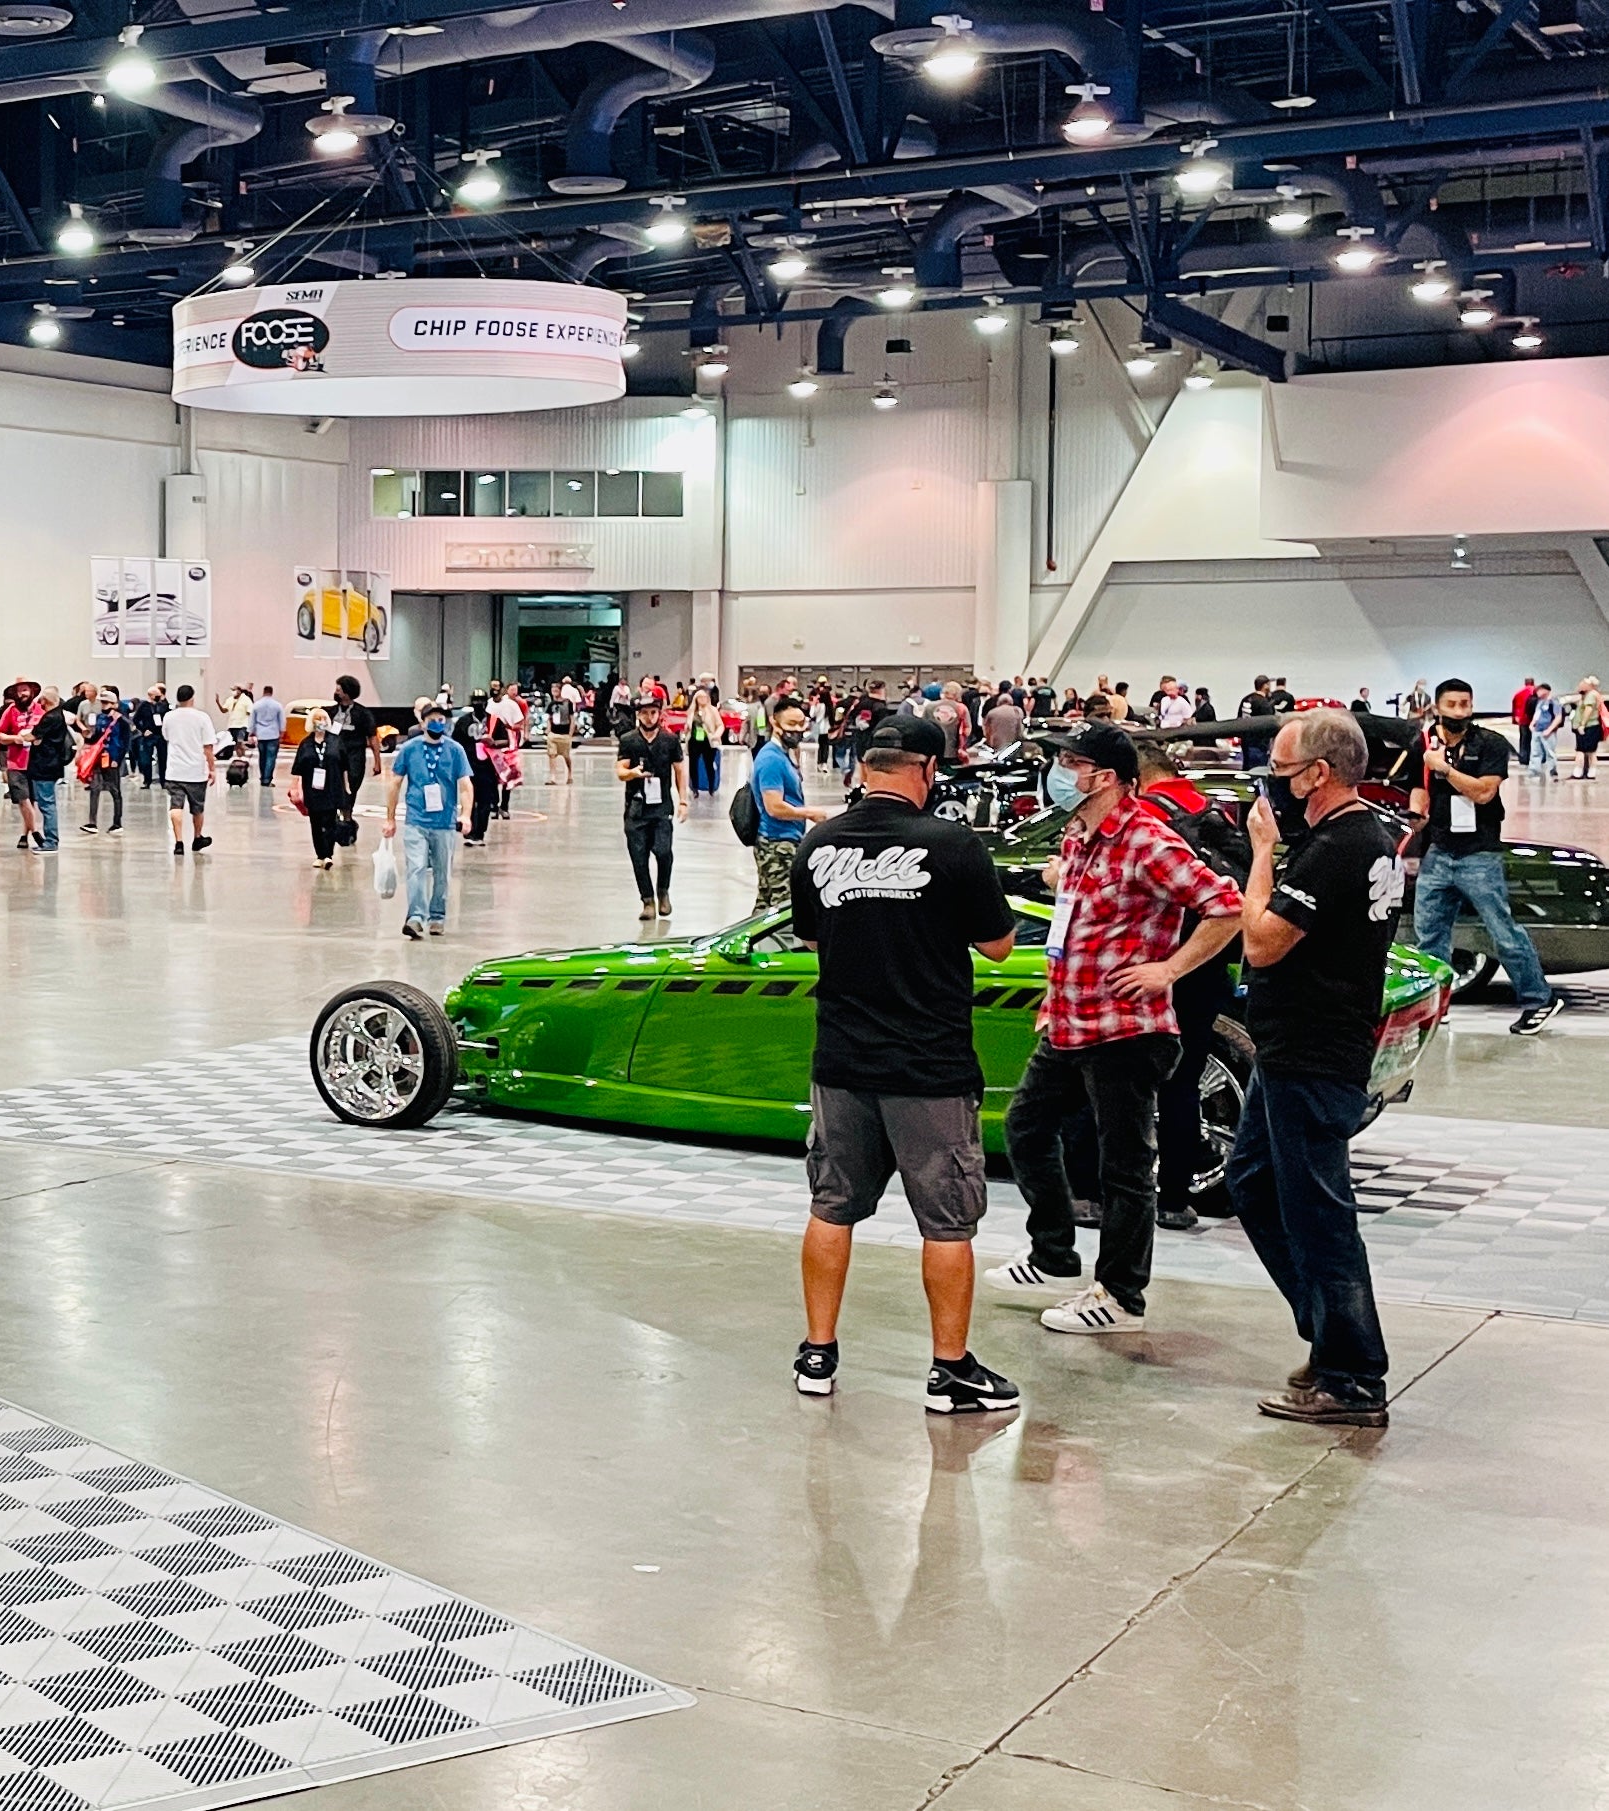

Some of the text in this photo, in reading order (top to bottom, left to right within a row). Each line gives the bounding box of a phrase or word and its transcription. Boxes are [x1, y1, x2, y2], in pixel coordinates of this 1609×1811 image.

[241, 317, 314, 347] FOOSE
[414, 320, 466, 335] CHIP
[475, 320, 539, 338] FOOSE
[807, 845, 931, 899] Webb
[845, 889, 916, 901] MOTORWORKS
